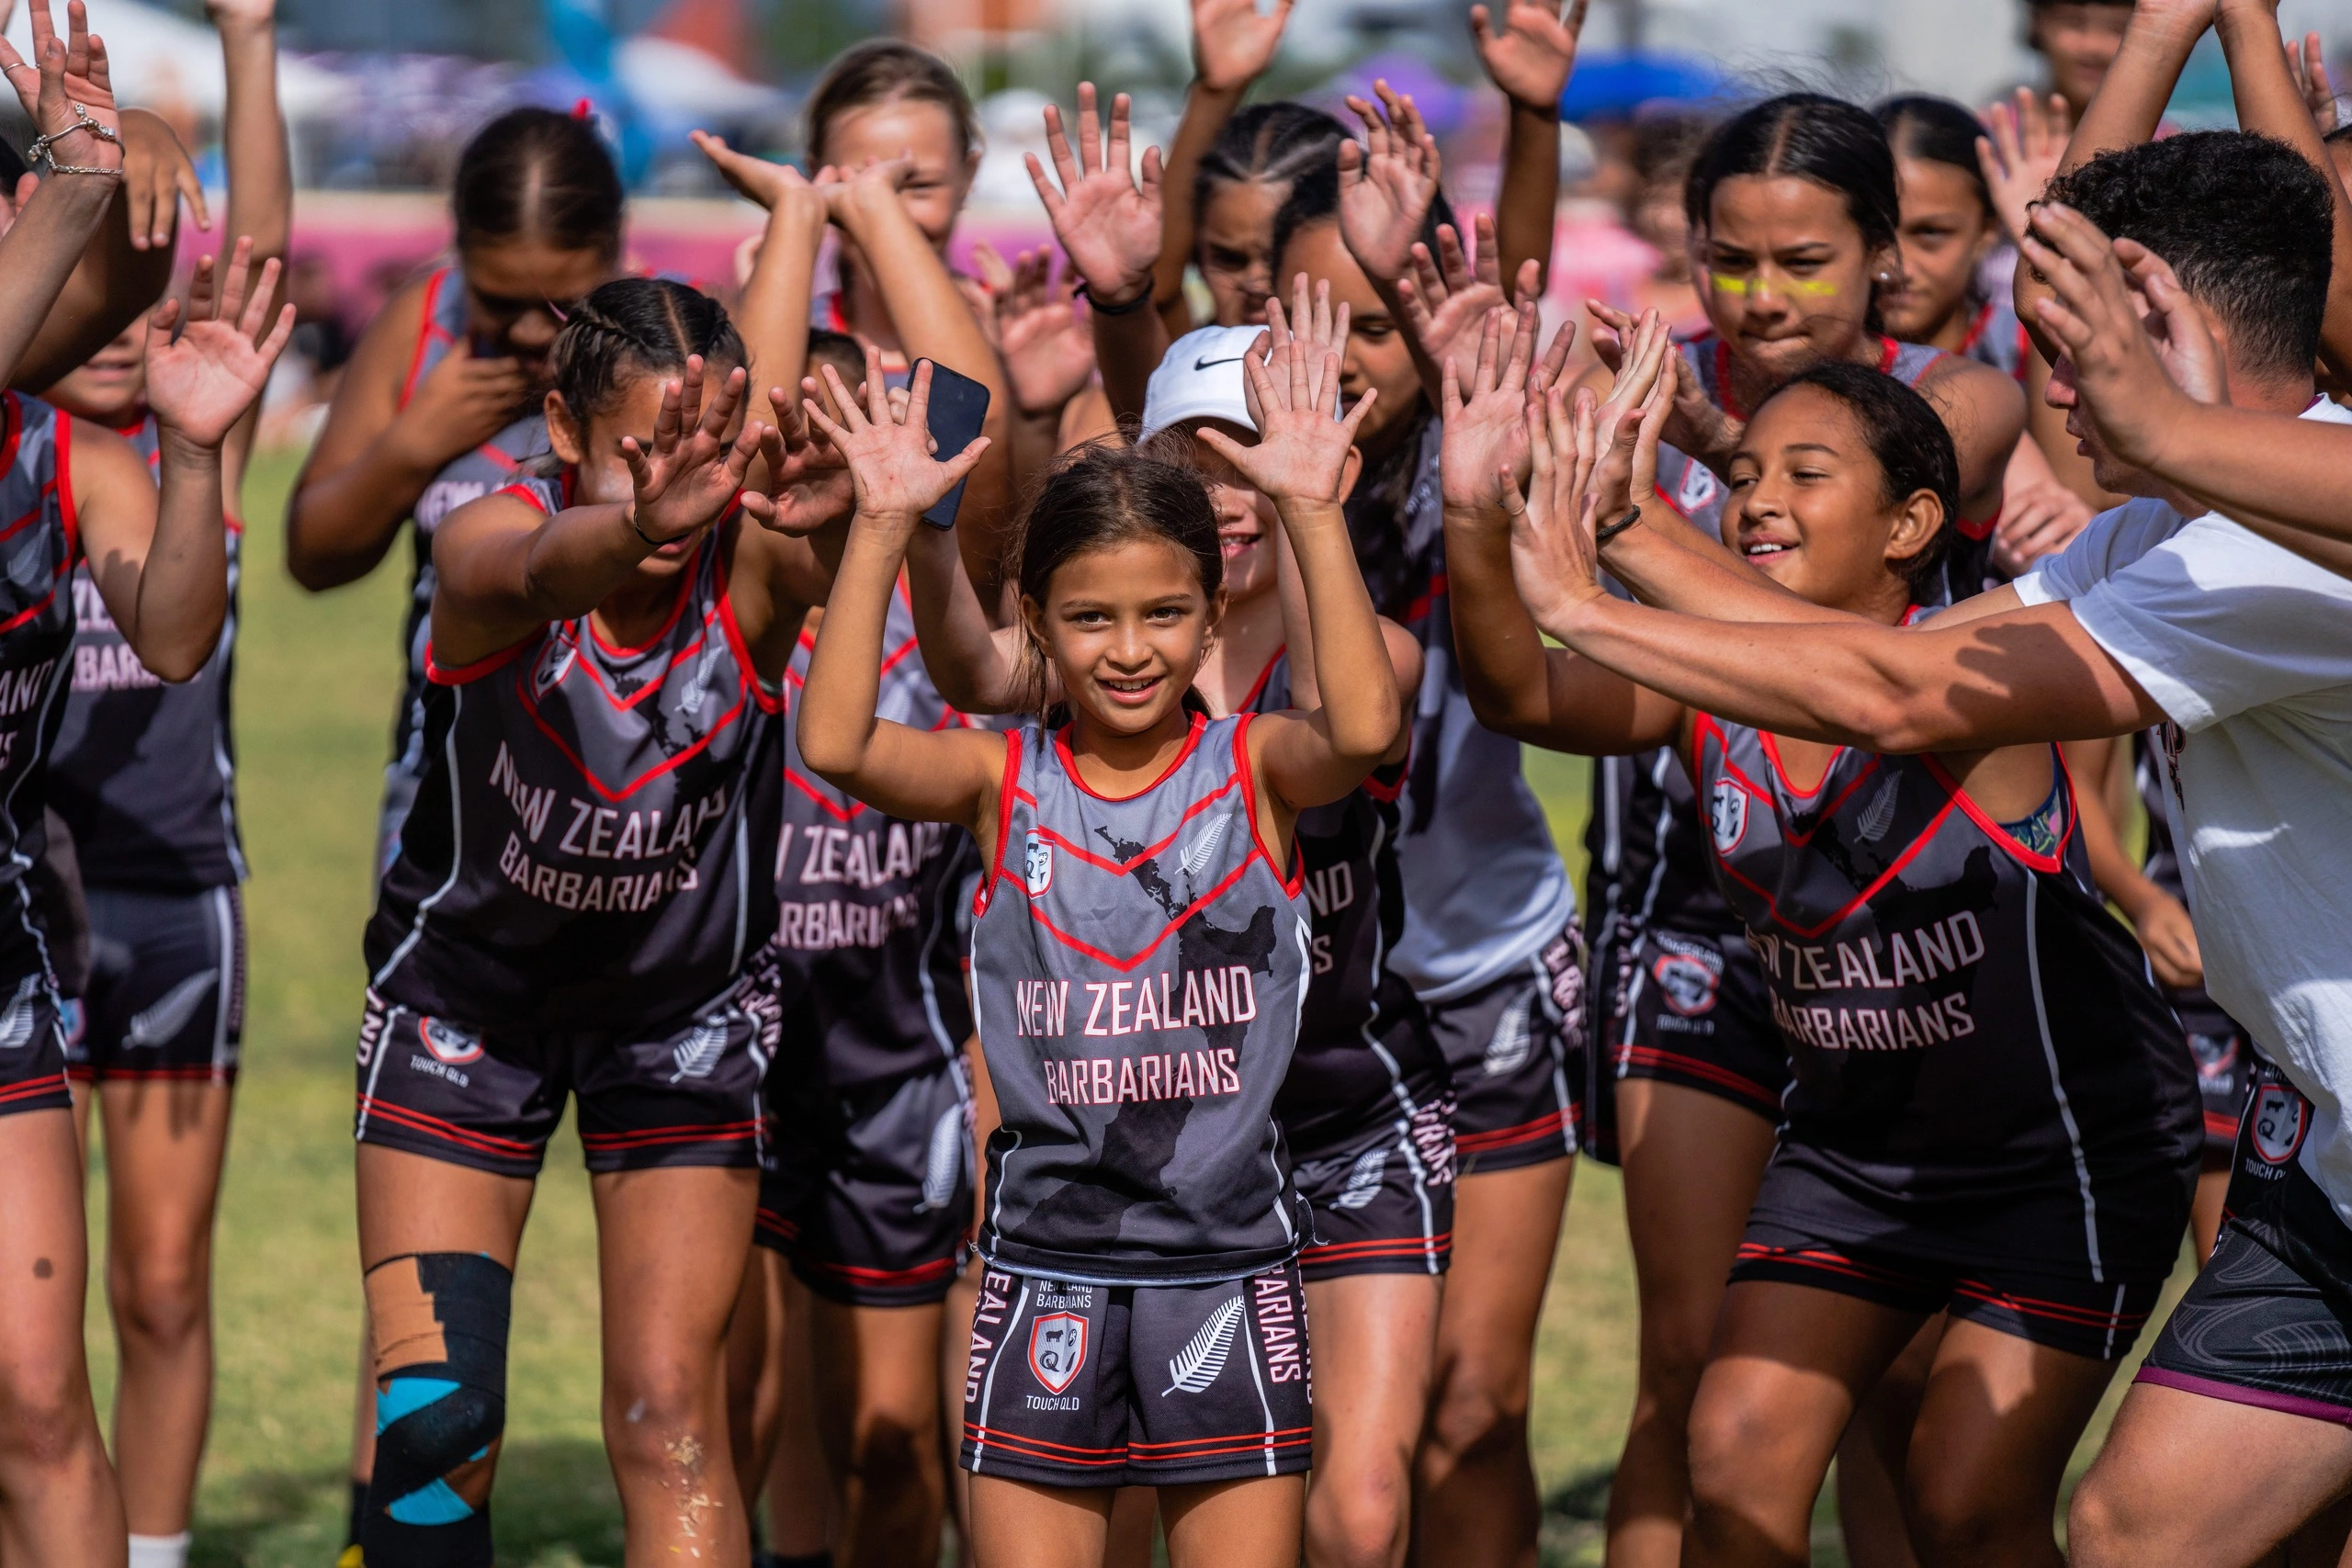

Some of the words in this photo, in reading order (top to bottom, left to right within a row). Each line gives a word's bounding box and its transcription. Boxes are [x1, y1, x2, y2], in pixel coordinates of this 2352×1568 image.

[1784, 909, 1985, 990] ZEALAND
[1016, 979, 1069, 1038] NEW
[1083, 964, 1258, 1037] ZEALAND
[1043, 1047, 1241, 1106] BARBARIANS
[2245, 1156, 2273, 1181] TOUCH
[965, 1270, 1012, 1404] EALAND
[1026, 1394, 1059, 1411] TOUCH
[1059, 1396, 1080, 1411] QLD
